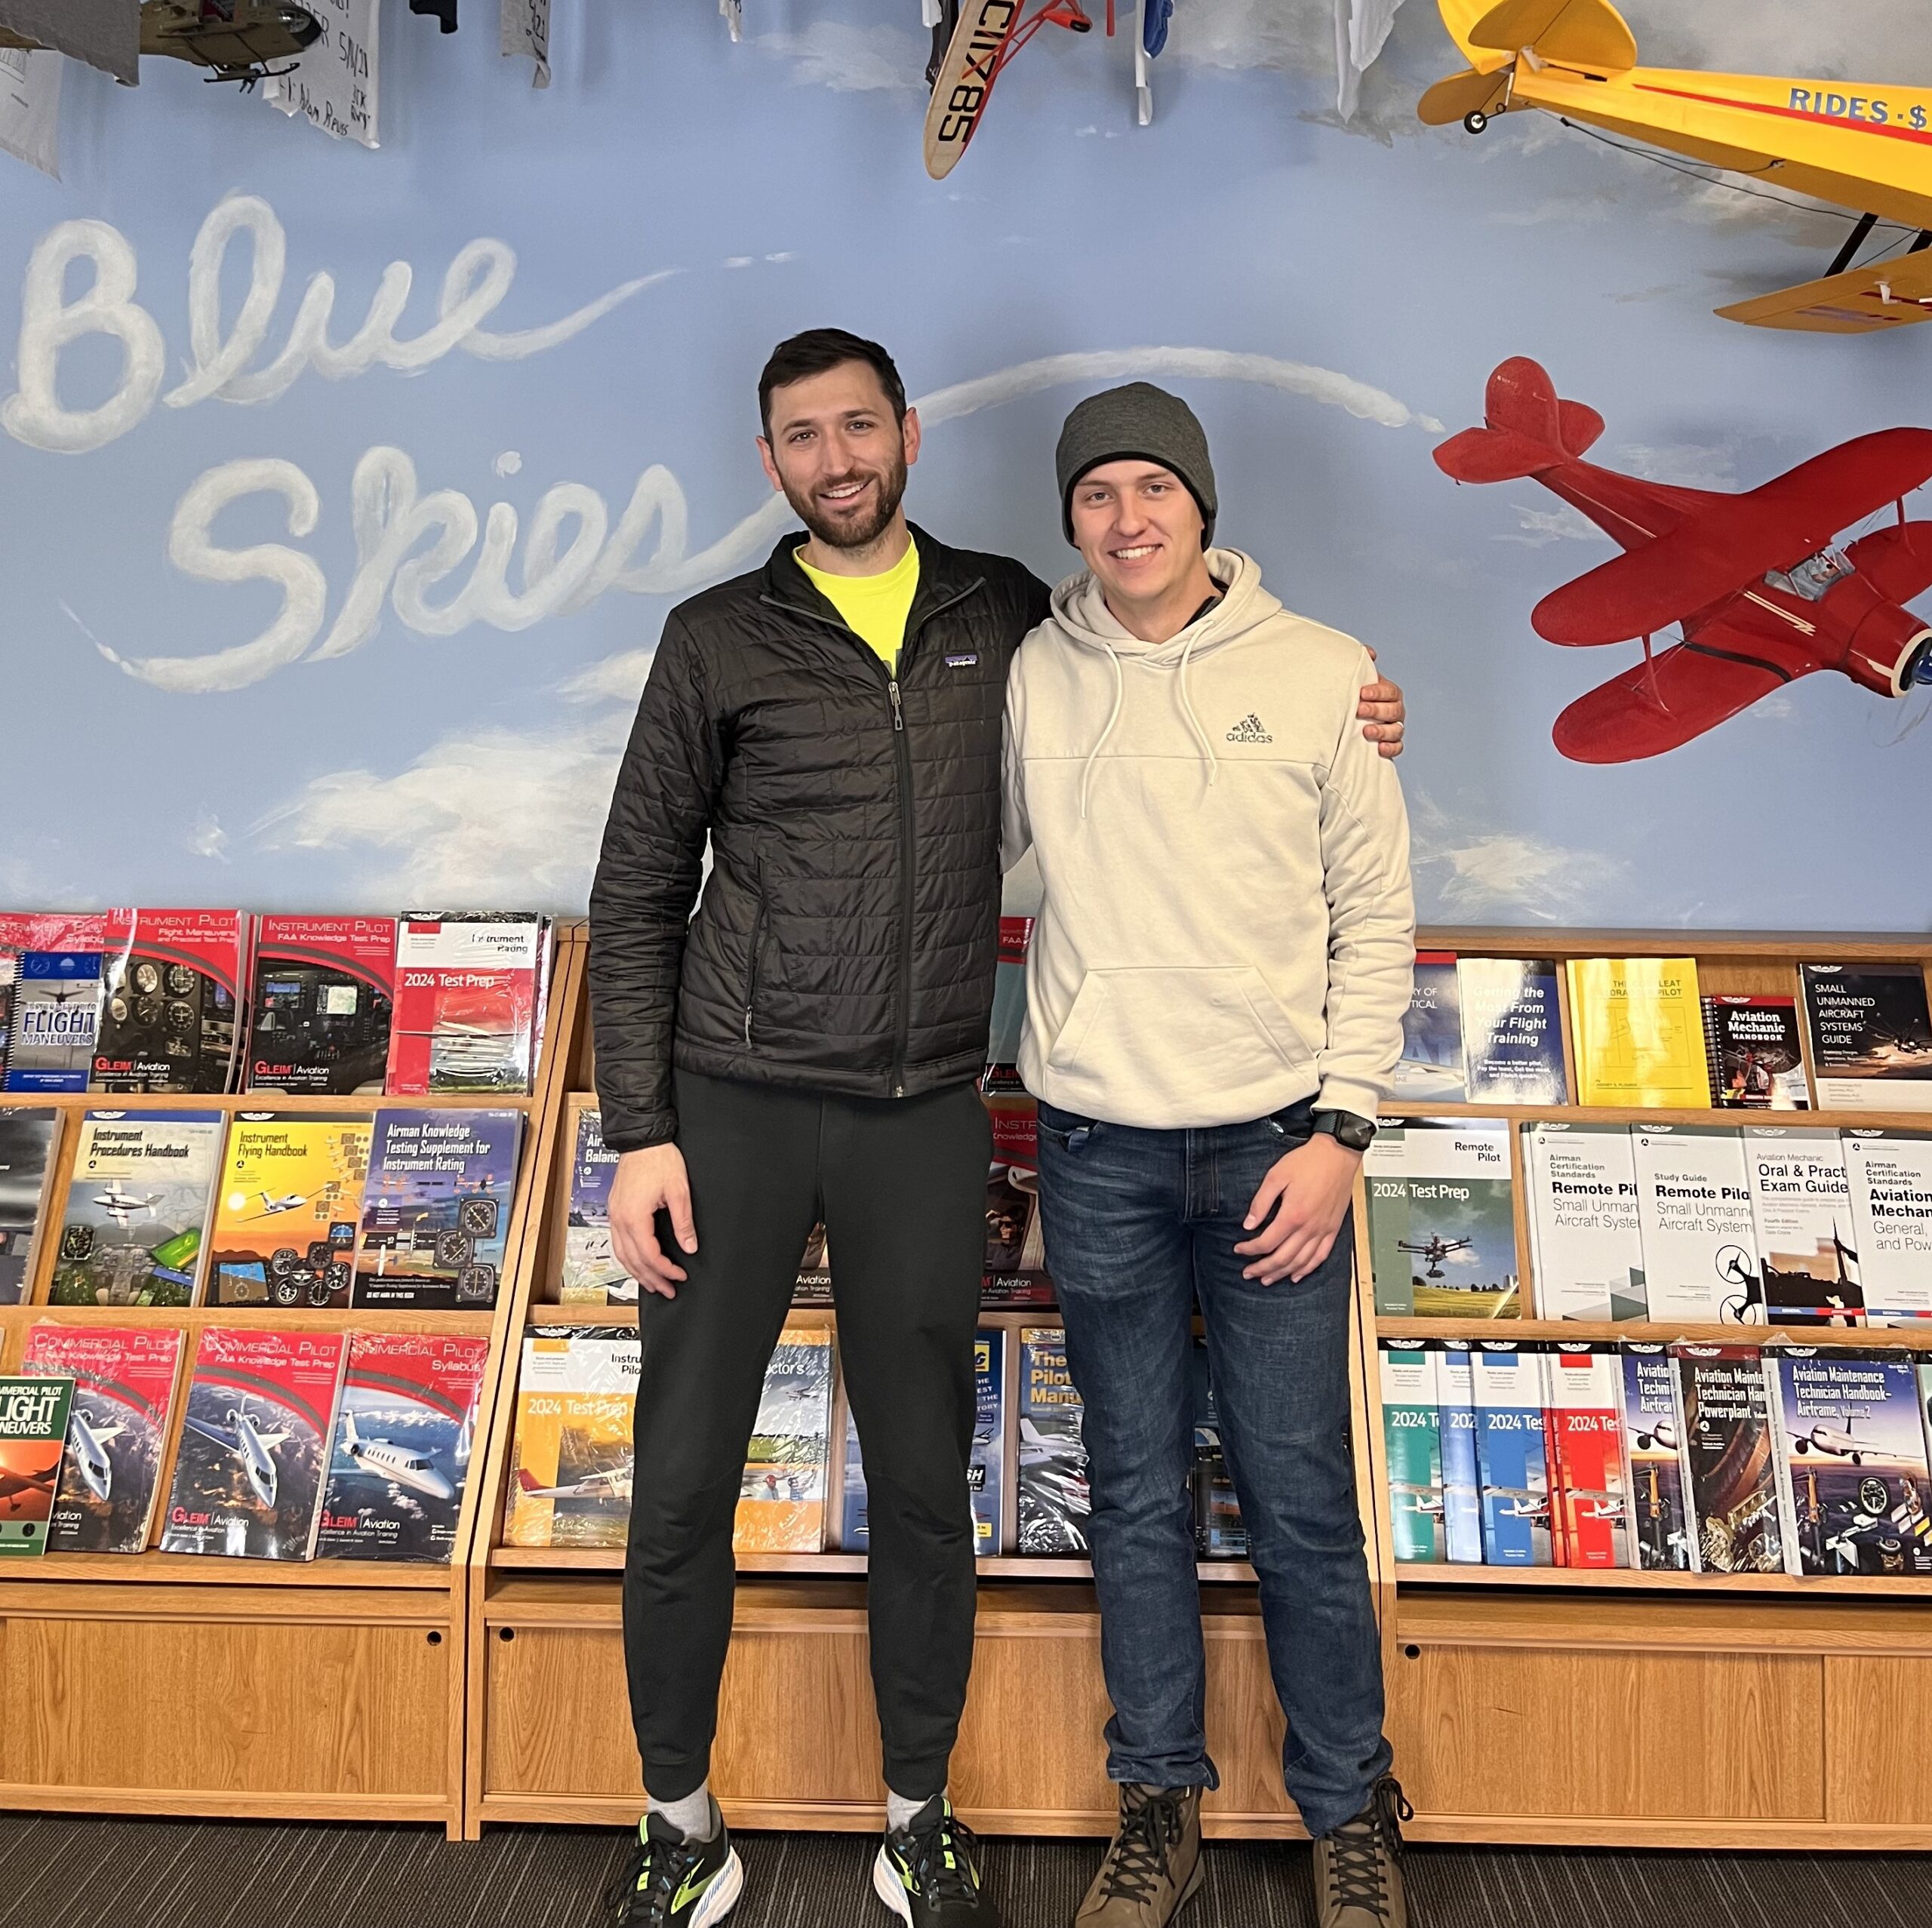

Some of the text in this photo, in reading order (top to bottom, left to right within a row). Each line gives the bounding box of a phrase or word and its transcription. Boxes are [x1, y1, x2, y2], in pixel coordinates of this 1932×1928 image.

[1789, 88, 1888, 124] RIDES
[0, 193, 604, 454] Blue
[113, 445, 709, 693] Skies
[1226, 732, 1273, 743] adidas
[198, 915, 235, 927] PILOT
[269, 920, 391, 933] INSTRUMENT PILOT
[158, 928, 183, 937] Flight
[300, 933, 348, 942] Knowledge
[349, 934, 368, 942] Test
[370, 935, 392, 943] Prep
[404, 973, 495, 989] 2024 Test Prep
[1423, 987, 1438, 996] OF
[1524, 987, 1544, 998] the
[1814, 984, 1847, 994] SMALL
[1510, 1002, 1544, 1013] From
[1817, 997, 1875, 1007] UNMANNED
[1730, 1010, 1781, 1022] Aviation
[1818, 1009, 1865, 1019] AIRCRAFT
[23, 1012, 96, 1033] FLIGHT
[1477, 1017, 1547, 1032] Your Flight
[1727, 1021, 1786, 1034] Mechanic
[1820, 1022, 1863, 1032] SYSTEMS
[21, 1033, 94, 1046] MANEUVERS
[1486, 1032, 1540, 1048] Training
[1732, 1033, 1783, 1041] HANDBOOK
[1821, 1035, 1853, 1044] GUIDE
[96, 1056, 171, 1071] GLEIM Aviation
[254, 1060, 330, 1075] GLEIM Aviation
[93, 1127, 143, 1142] Instrument
[239, 1131, 289, 1144] Instrument
[387, 1123, 471, 1140] Airman Knowledge
[90, 1142, 190, 1158] Procedures Handbook
[238, 1145, 308, 1159] Flying Handbook
[386, 1140, 491, 1158] Testing Supplement for
[1454, 1142, 1494, 1152] Remote
[586, 1148, 620, 1164] Balanc
[1478, 1152, 1500, 1163] Pilot
[1549, 1154, 1581, 1162] Airman
[1756, 1153, 1824, 1162] Aviation Mechanic
[383, 1157, 466, 1174] Instrument Rating
[1549, 1162, 1605, 1171] Certification
[1758, 1164, 1847, 1178] Oral & Pract
[1865, 1161, 1897, 1169] Airman
[1550, 1170, 1596, 1179] Standards
[1654, 1173, 1708, 1182] Study Guide
[1866, 1169, 1921, 1178] Certification
[1761, 1179, 1849, 1194] Exam Guide
[1867, 1177, 1913, 1185] Standards
[1373, 1183, 1470, 1201] 2024 Test Prep
[1552, 1182, 1638, 1196] Remote Pil
[1655, 1185, 1717, 1199] Remote
[1869, 1188, 1932, 1202] Aviation
[1552, 1198, 1587, 1213] Small
[1657, 1201, 1691, 1215] Small
[1554, 1214, 1599, 1227] Aircraft
[1658, 1217, 1703, 1232] Aircraft
[1873, 1221, 1928, 1236] General,
[1876, 1237, 1902, 1250] and
[796, 1275, 831, 1285] Aviation
[995, 1277, 1032, 1287] Aviation
[34, 1333, 128, 1351] COMMERCIAL
[205, 1335, 338, 1357] COMMERCIAL PILOT
[125, 1353, 146, 1361] Test
[149, 1354, 173, 1362] Prep
[215, 1354, 235, 1363] FAA
[291, 1358, 310, 1367] Test
[312, 1359, 335, 1369] Prep
[1034, 1351, 1067, 1367] The
[432, 1359, 481, 1373] Syllabus
[1636, 1361, 1669, 1378] Aviatio
[1695, 1367, 1764, 1384] Aviation Mainte
[1792, 1365, 1828, 1382] Aviation
[1829, 1367, 1885, 1383] Maintenance
[40, 1386, 63, 1396] PILOT
[982, 1394, 998, 1402] THE
[1695, 1384, 1766, 1401] Technician Han
[1794, 1383, 1841, 1400] Technician
[527, 1398, 594, 1416] 2024 Test
[1698, 1402, 1752, 1422] Powerplant
[1797, 1400, 1839, 1418] Airframe,
[1865, 1405, 1872, 1418] 2
[1391, 1412, 1426, 1428] 2024
[1488, 1413, 1522, 1430] 2024
[1567, 1416, 1598, 1431] 2024
[214, 1514, 250, 1527] Aviation
[362, 1517, 401, 1530] Aviation
